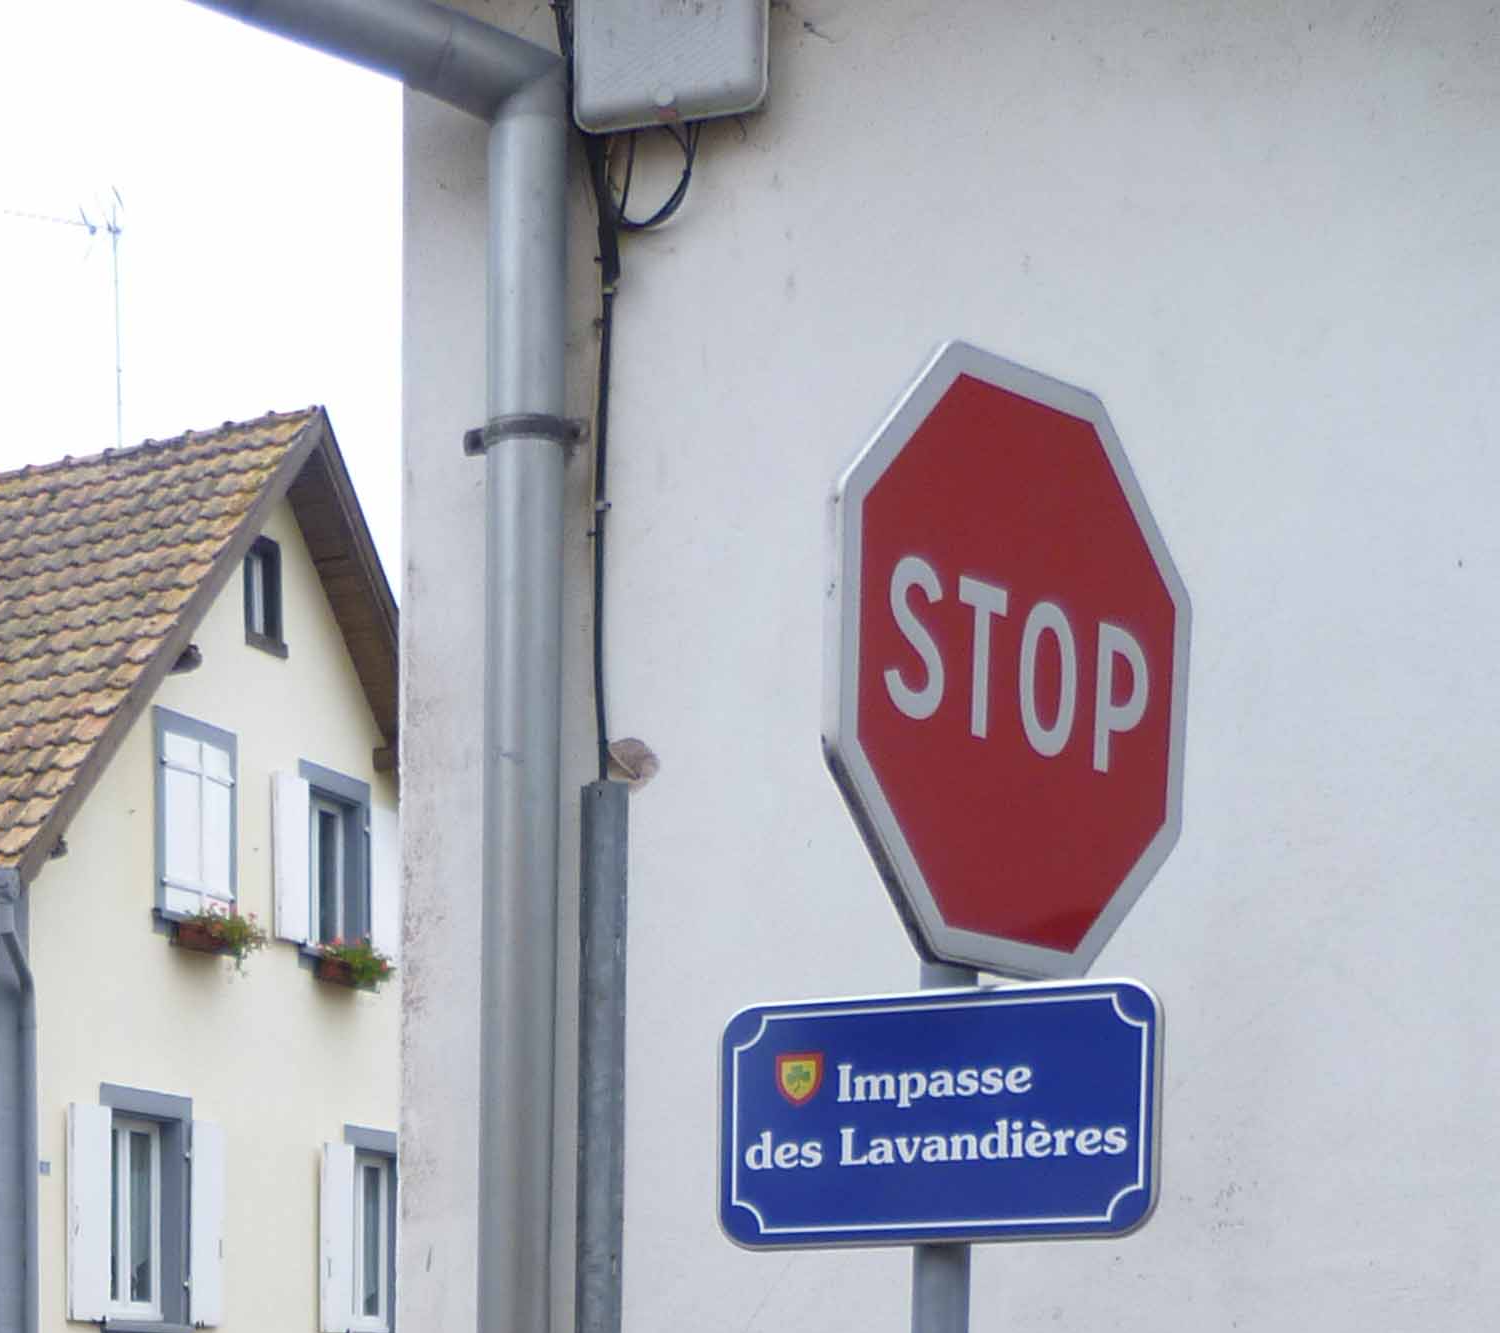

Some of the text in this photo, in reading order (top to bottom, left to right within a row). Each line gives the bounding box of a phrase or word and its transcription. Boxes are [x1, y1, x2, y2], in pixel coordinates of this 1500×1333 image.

[884, 556, 1148, 773] STOP
[837, 1064, 1032, 1107] Impasse
[745, 1119, 1127, 1170] des Lavandières
